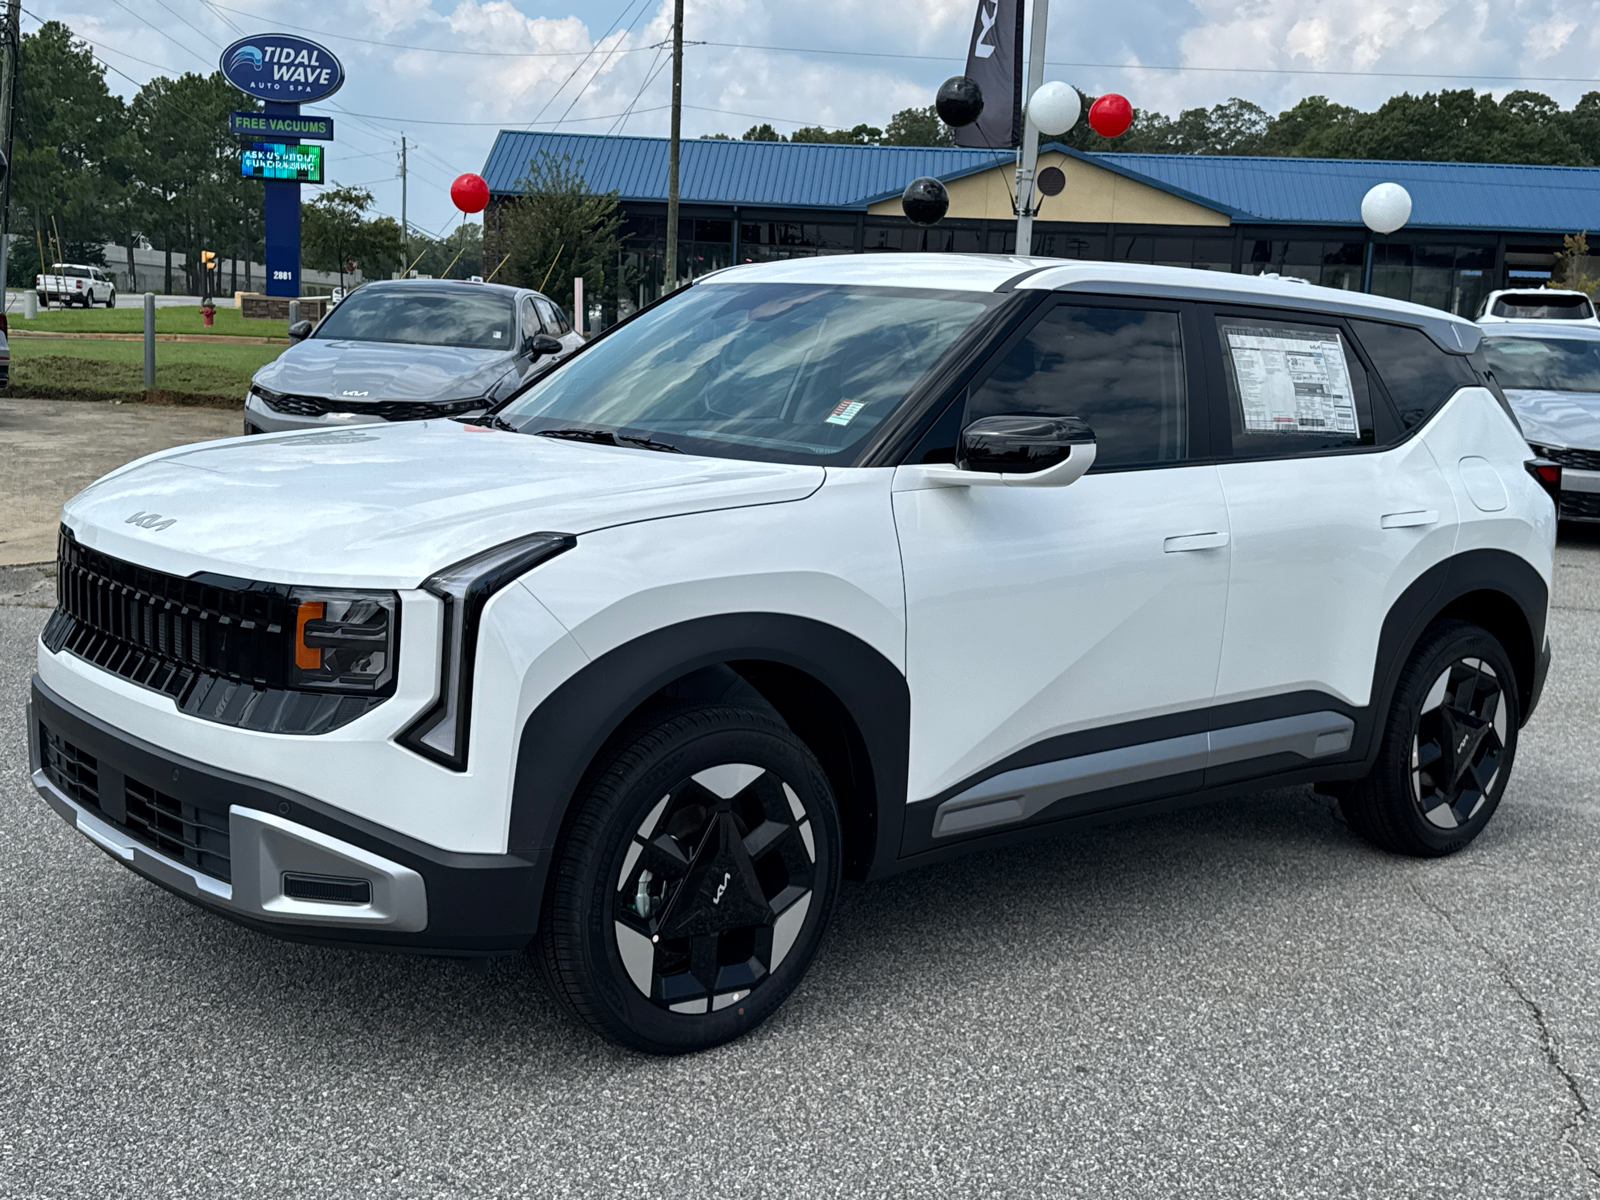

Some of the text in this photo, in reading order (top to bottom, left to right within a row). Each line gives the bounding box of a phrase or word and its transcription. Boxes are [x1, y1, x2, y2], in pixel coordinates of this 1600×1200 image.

[264, 46, 320, 66] TIDAL
[273, 64, 331, 85] WAVE
[250, 81, 312, 93] AUTO SPA
[235, 116, 326, 133] FREE VACUUMS
[124, 510, 178, 532] KIA
[712, 872, 731, 905] KIA
